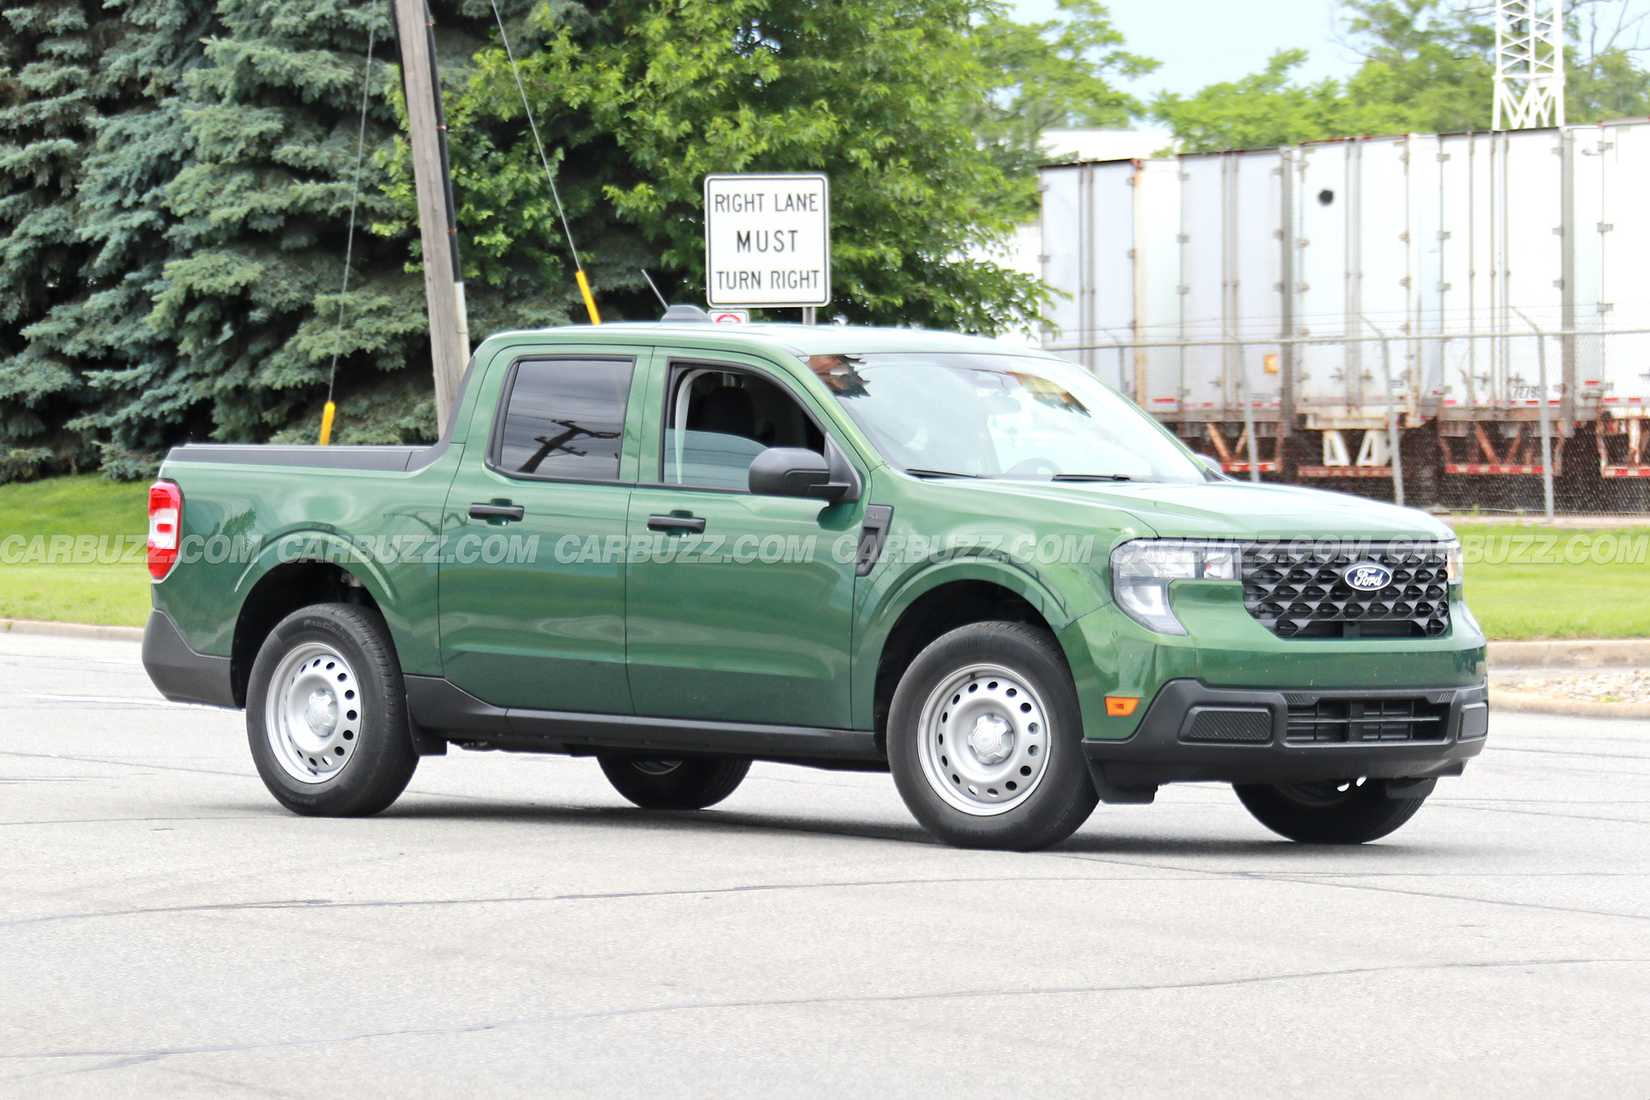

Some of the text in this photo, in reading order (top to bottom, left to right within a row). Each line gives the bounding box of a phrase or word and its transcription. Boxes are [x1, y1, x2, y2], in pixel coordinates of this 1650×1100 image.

[715, 193, 818, 213] RIGHT LANE
[736, 230, 798, 253] MUST
[716, 270, 819, 290] TURN RIGHT
[1353, 567, 1385, 587] Ford
